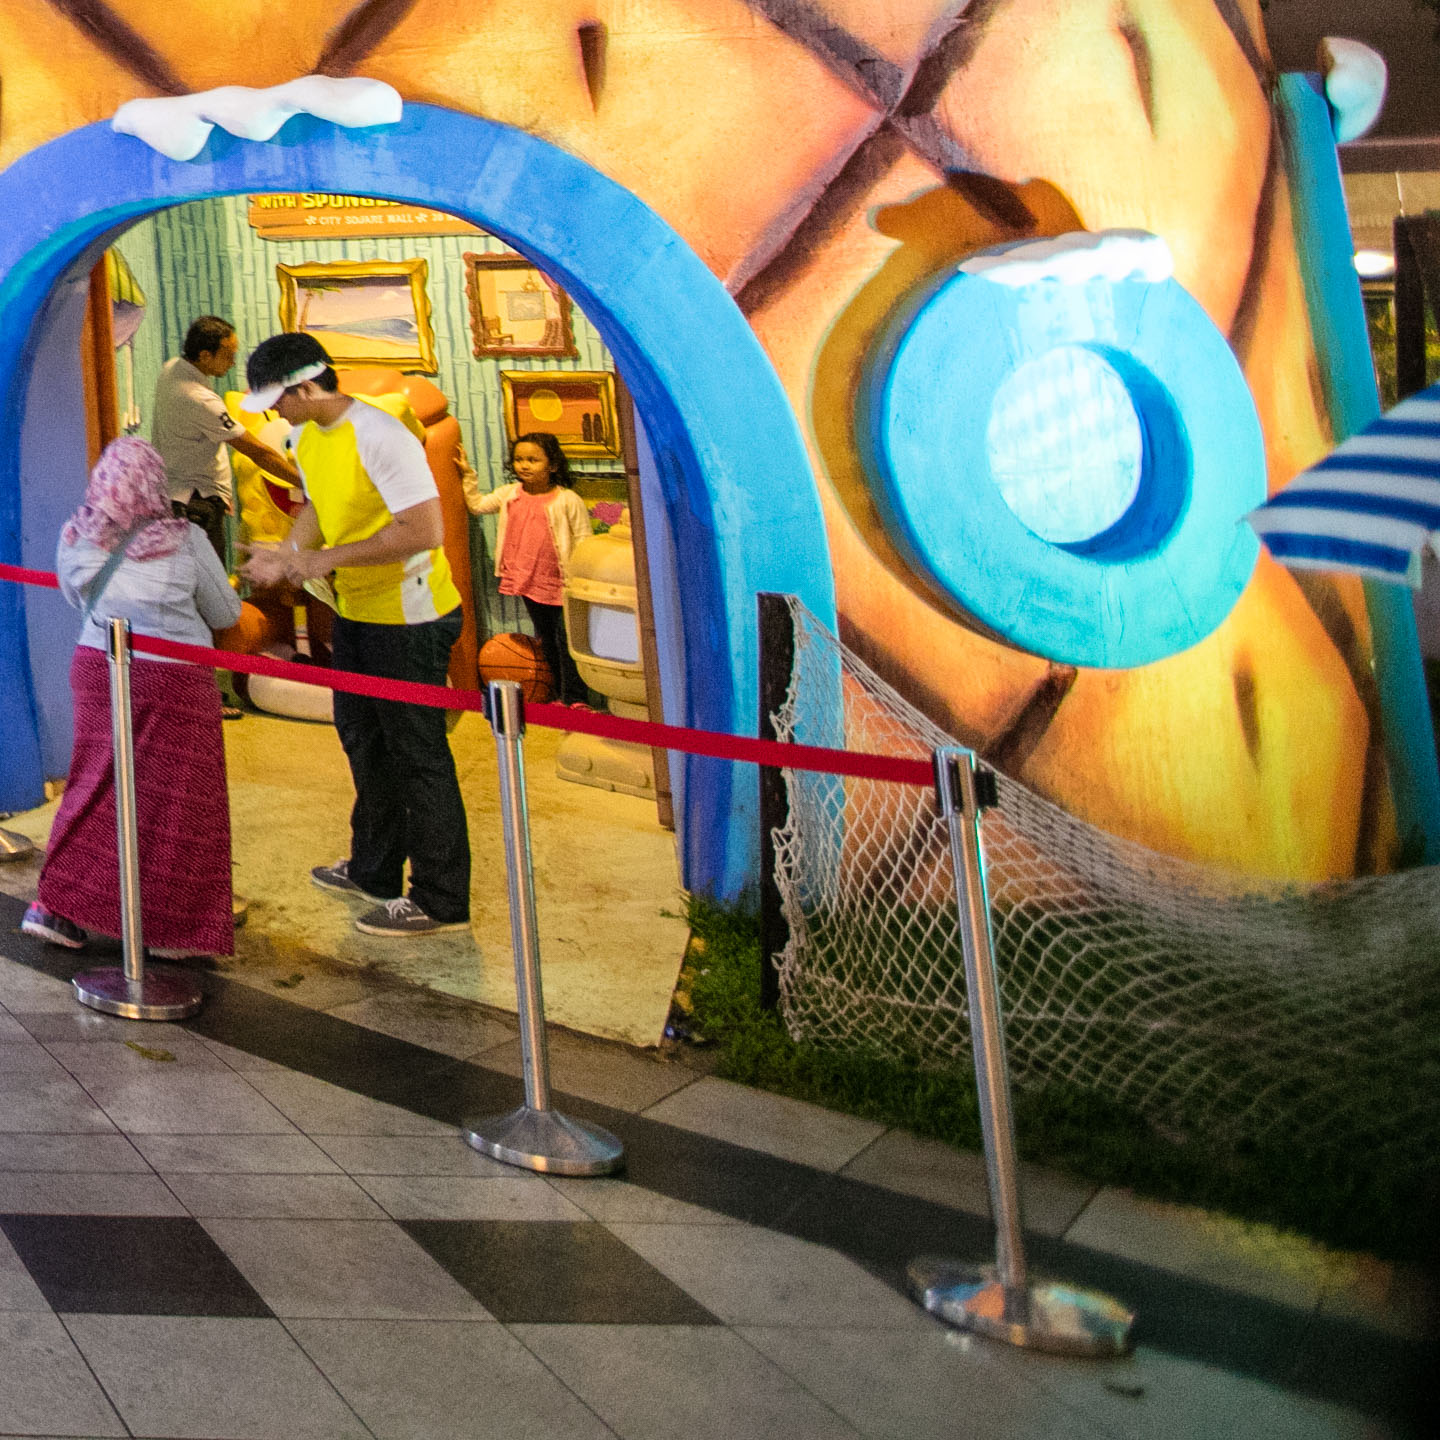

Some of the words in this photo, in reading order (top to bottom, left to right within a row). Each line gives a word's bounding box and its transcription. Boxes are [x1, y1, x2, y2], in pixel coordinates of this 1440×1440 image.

[318, 216, 342, 225] CITY
[344, 215, 385, 225] SQUARE
[386, 213, 414, 224] MALL
